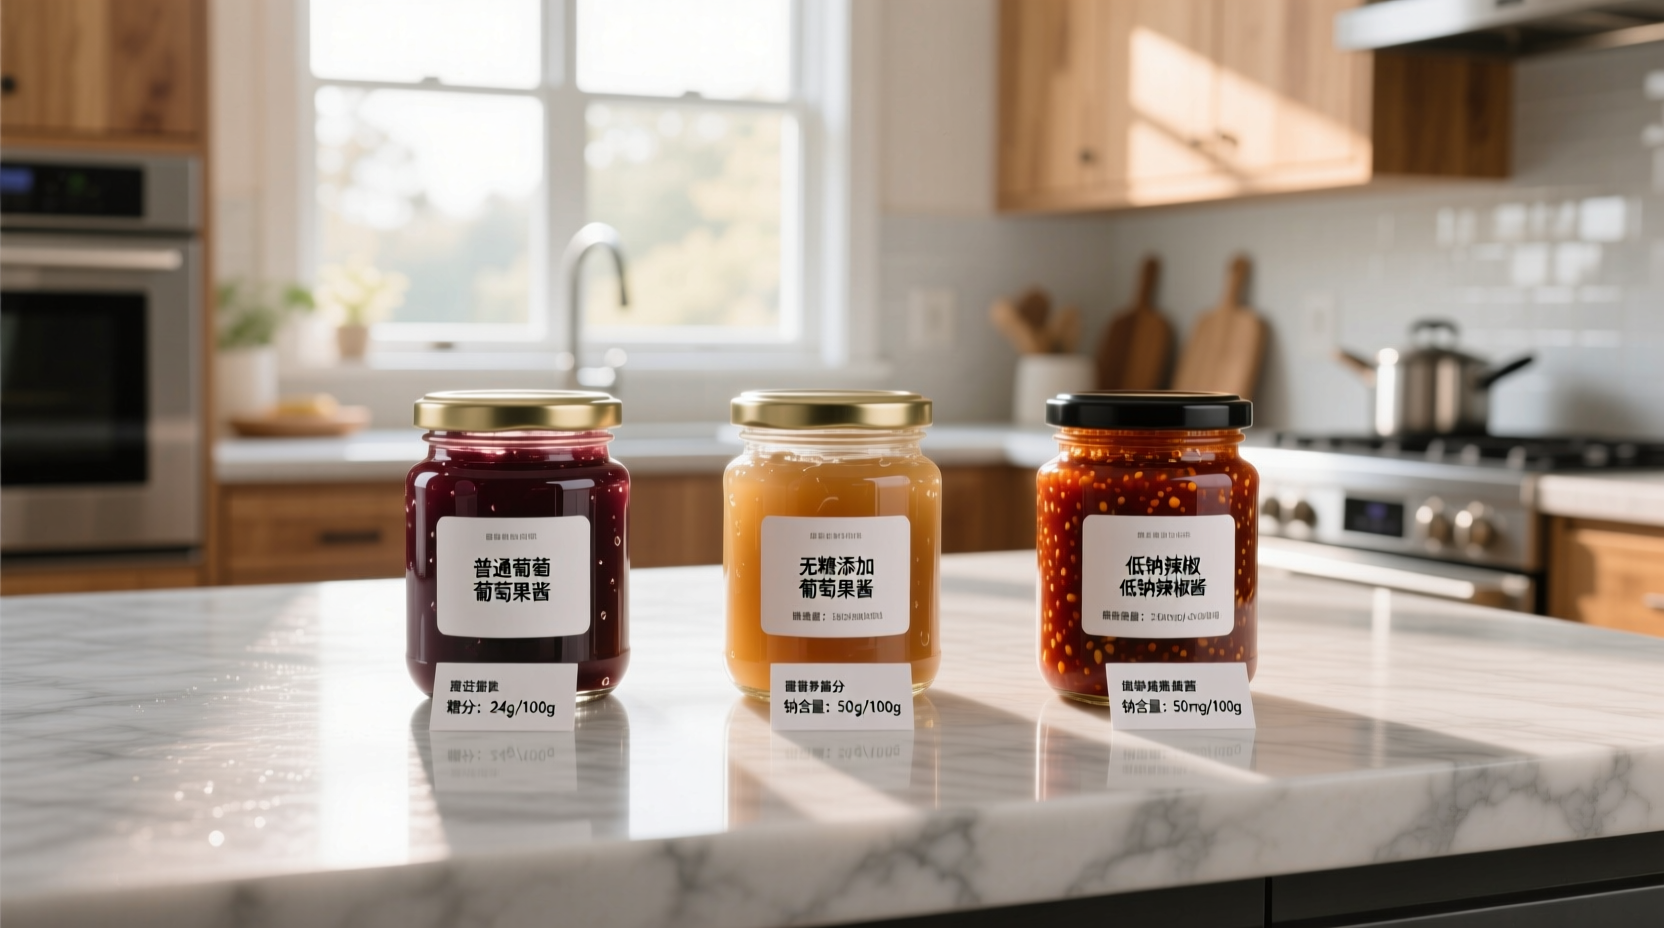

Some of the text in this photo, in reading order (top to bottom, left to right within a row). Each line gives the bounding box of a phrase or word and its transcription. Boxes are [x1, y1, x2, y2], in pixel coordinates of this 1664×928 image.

[473, 556, 551, 578] 普通葡萄
[473, 580, 551, 603] 葡萄果酱
[798, 578, 874, 600] 葡萄果酱
